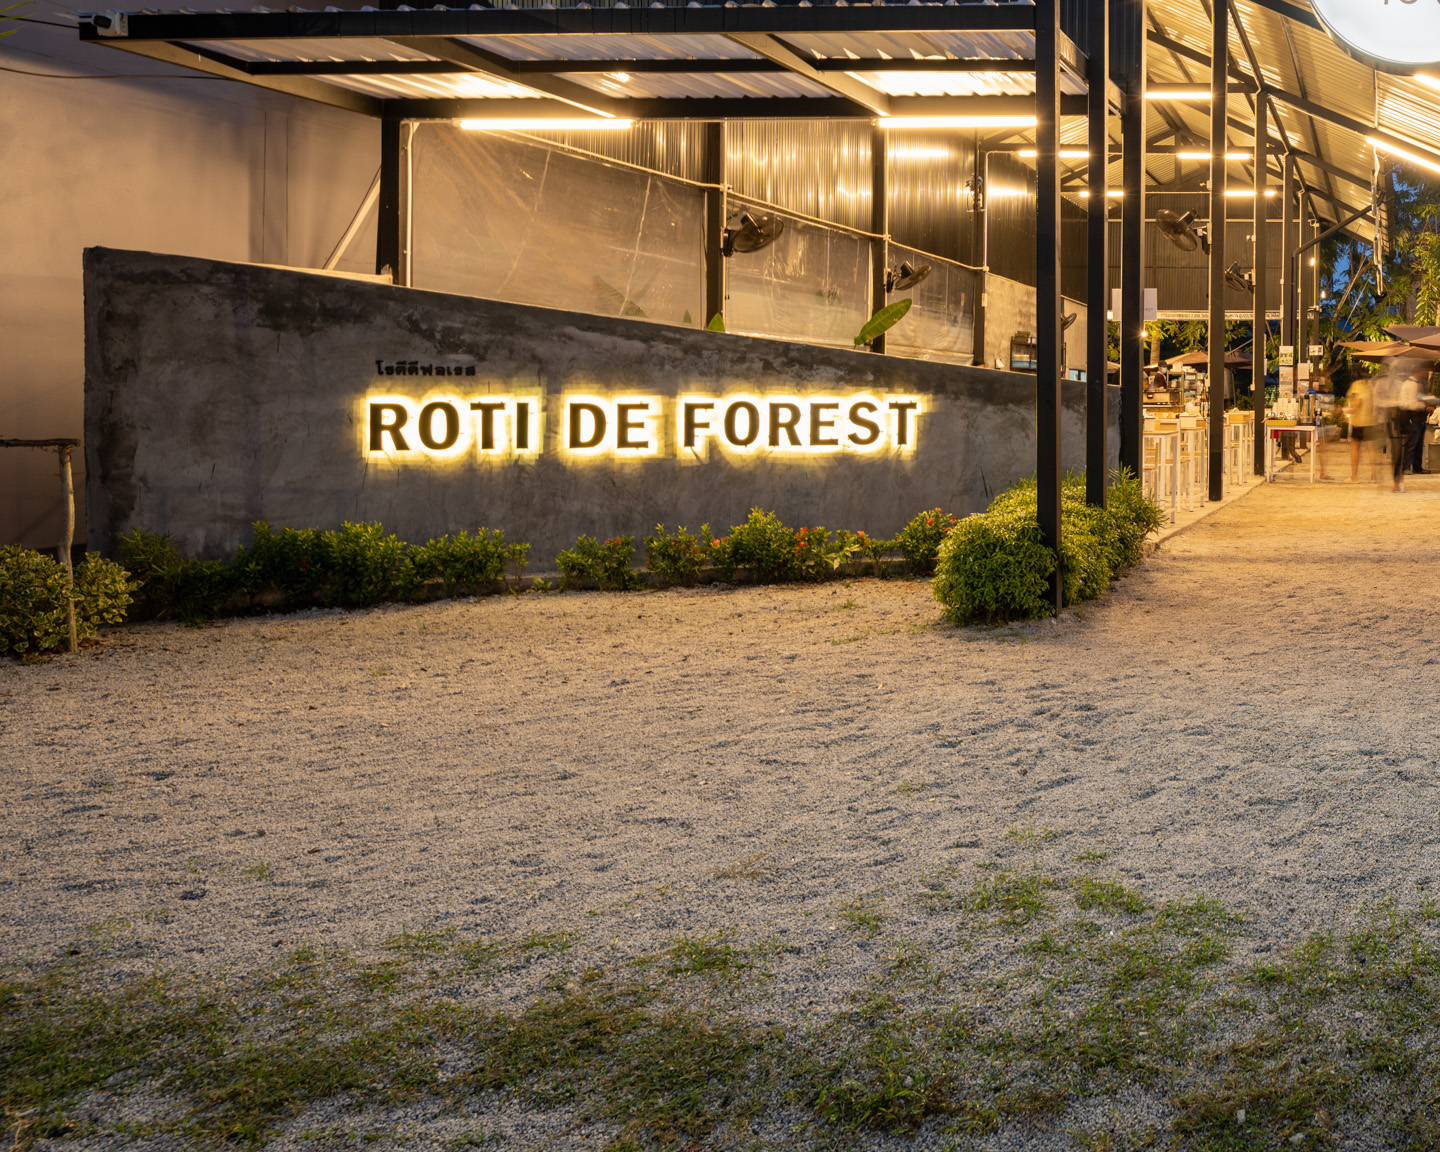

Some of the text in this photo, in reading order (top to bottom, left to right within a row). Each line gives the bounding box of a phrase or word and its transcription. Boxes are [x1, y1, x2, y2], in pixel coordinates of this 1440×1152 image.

[369, 400, 917, 451] ROTI DE FOREST
